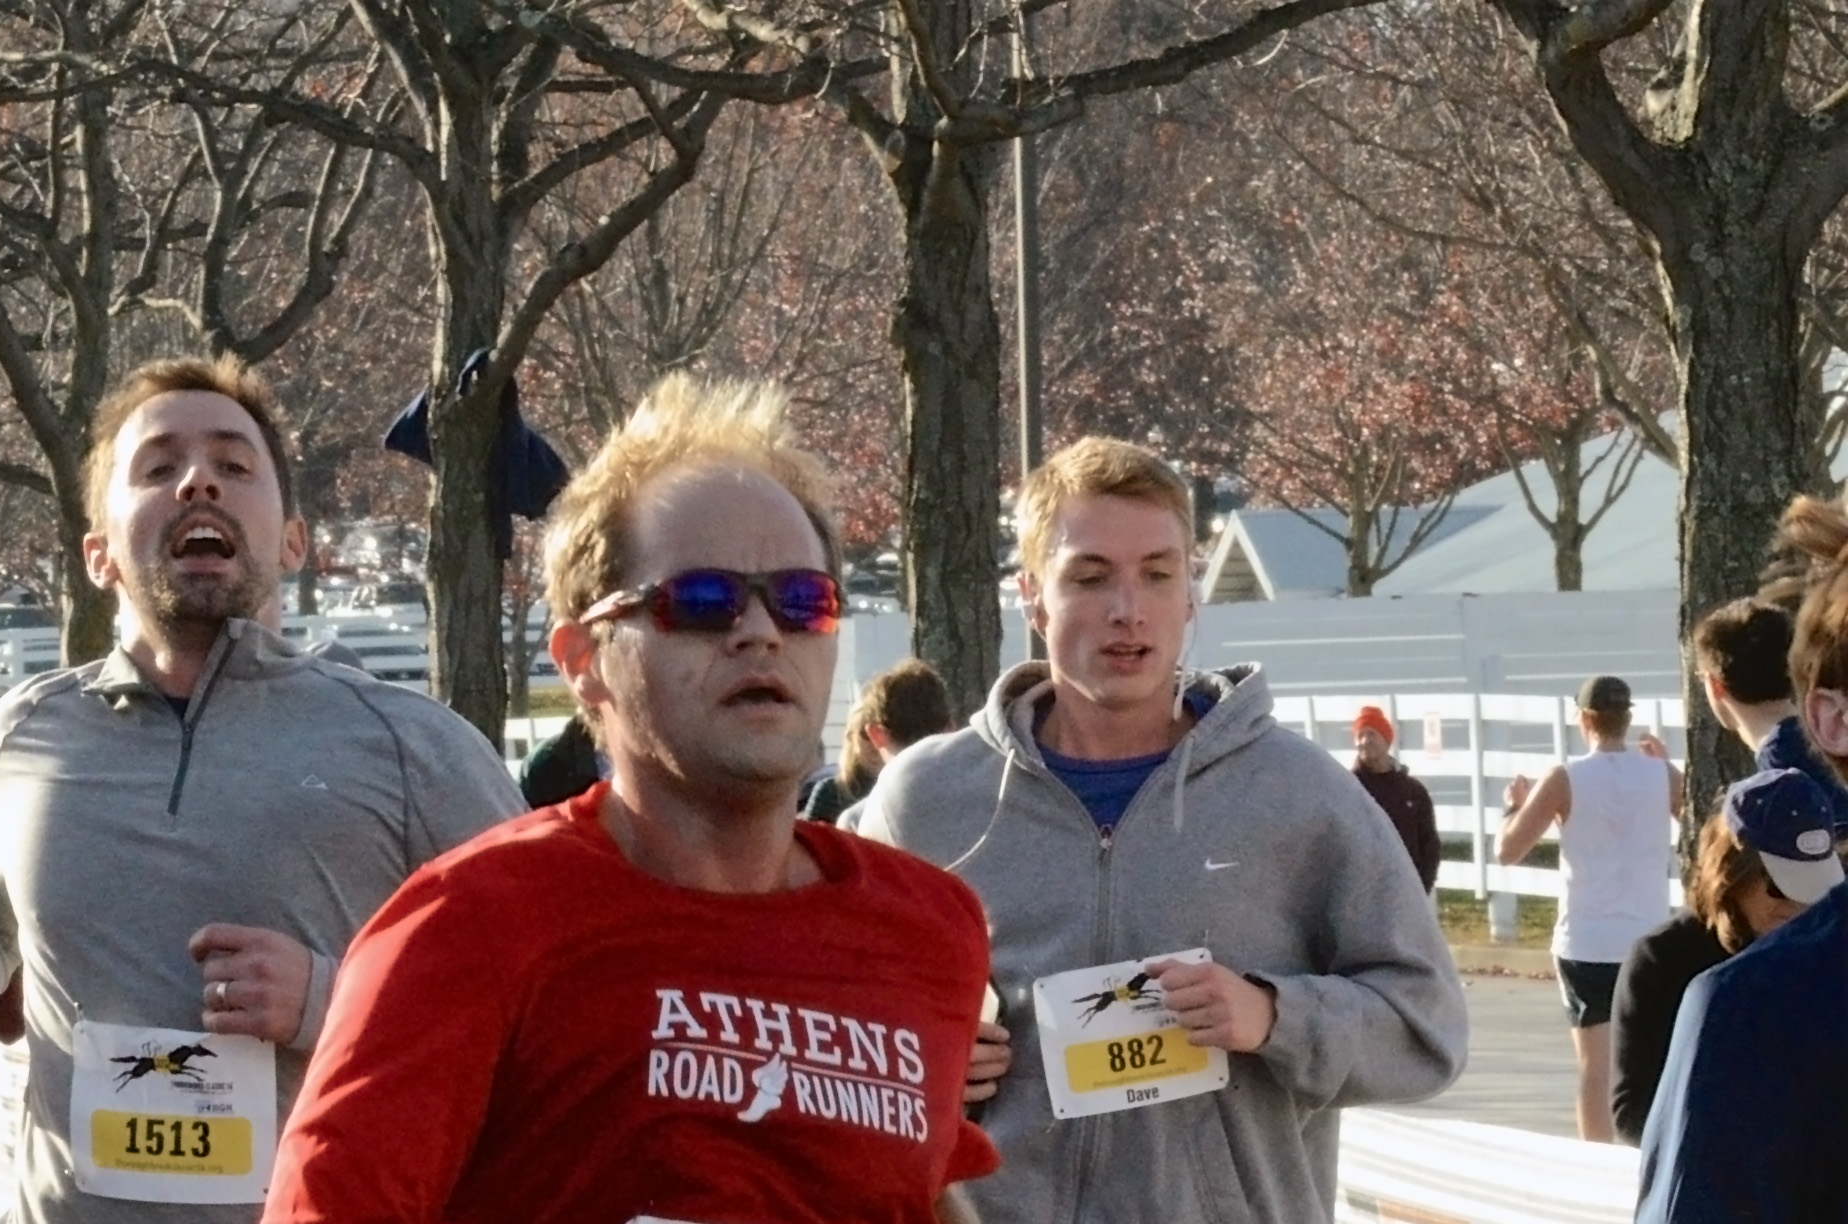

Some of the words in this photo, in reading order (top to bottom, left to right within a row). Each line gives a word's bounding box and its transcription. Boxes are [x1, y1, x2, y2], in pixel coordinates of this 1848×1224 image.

[651, 989, 925, 1085] ATHENS
[1107, 1034, 1167, 1073] 882
[648, 1049, 744, 1104] ROAD
[791, 1071, 928, 1143] RUNNERS
[1126, 1086, 1160, 1104] Dave
[125, 1117, 211, 1158] 1513
